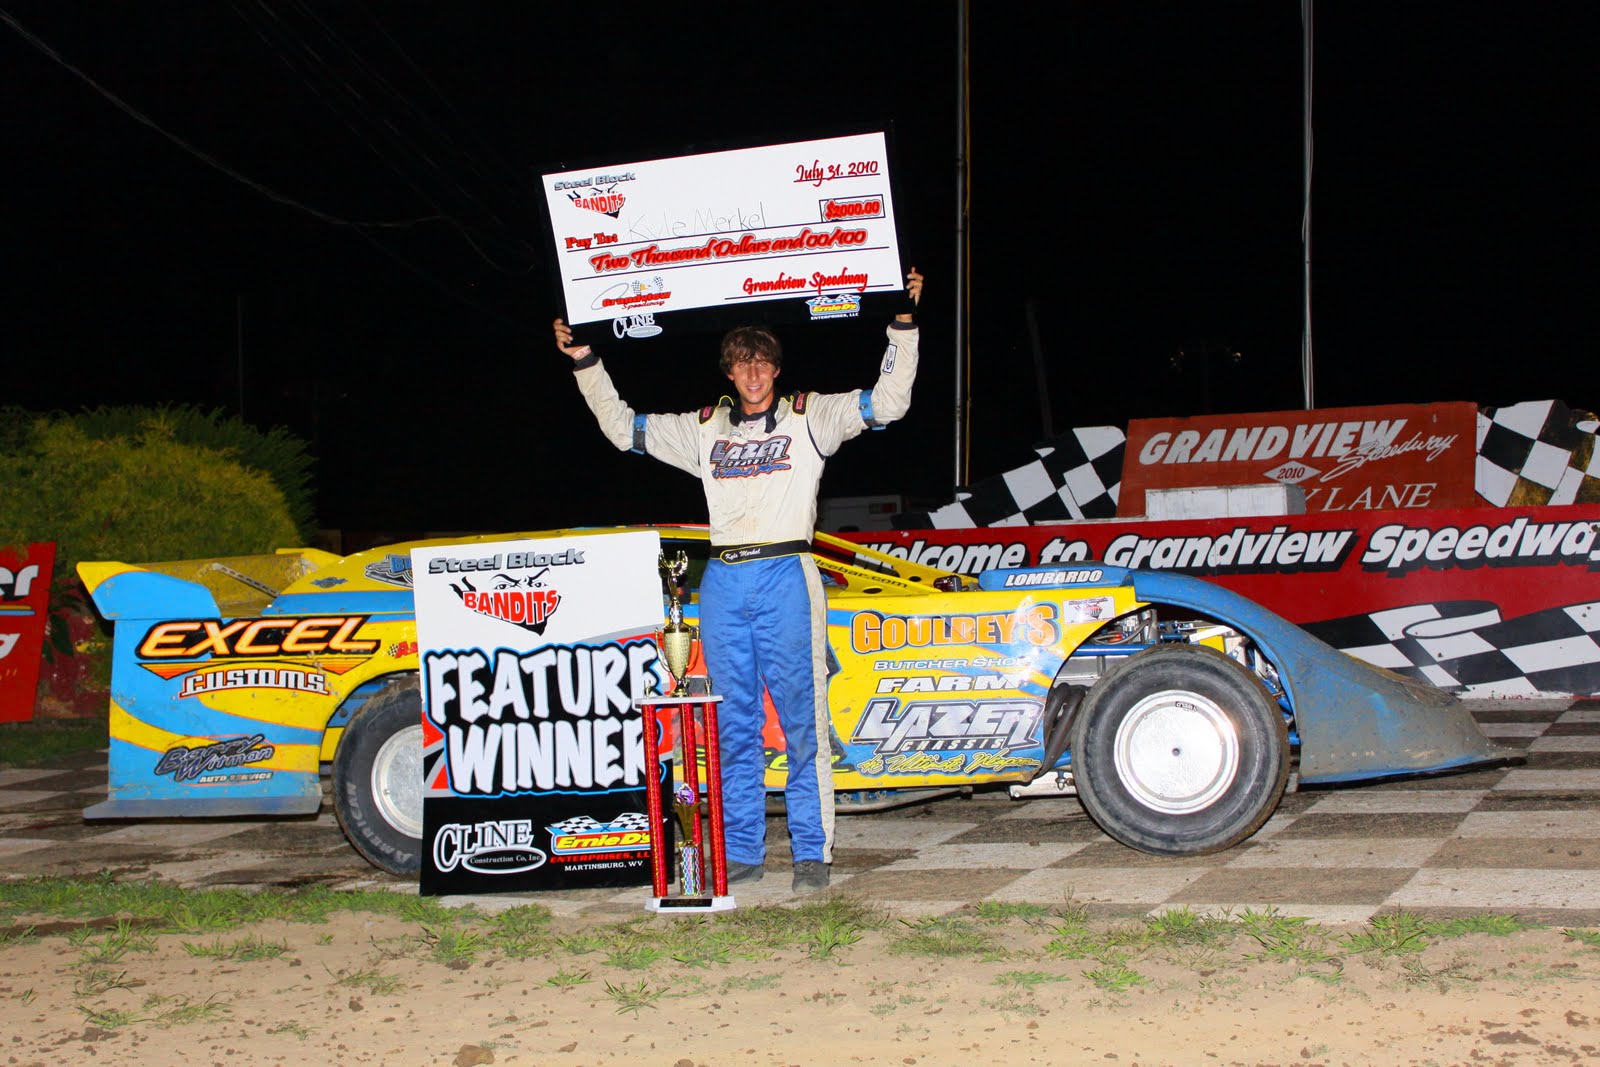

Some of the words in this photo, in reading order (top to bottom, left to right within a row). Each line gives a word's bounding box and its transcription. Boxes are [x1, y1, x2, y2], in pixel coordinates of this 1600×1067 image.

[554, 176, 593, 191] Steel
[595, 172, 636, 185] Block
[795, 159, 823, 187] July
[848, 161, 878, 176] 2010
[574, 193, 625, 214] BANDITS
[824, 199, 881, 220] $2000.00
[628, 210, 686, 245] Kyle
[694, 201, 767, 235] Merkel
[565, 236, 592, 249] Pay
[594, 232, 618, 245] To:
[589, 252, 631, 273] Two
[631, 236, 716, 268] Thousand
[714, 232, 772, 259] Dollars
[771, 228, 809, 253] and
[806, 226, 867, 250] 00/100
[743, 272, 806, 295] Grandview
[809, 267, 868, 294] Speedway
[602, 291, 671, 307] Grandview
[622, 300, 665, 310] Speedway
[613, 313, 655, 339] CLINE
[711, 436, 790, 467] LAZER
[1139, 418, 1408, 465] GRANDVIEW
[1320, 431, 1458, 482] Speedway
[1277, 466, 1306, 480] 2010
[1321, 483, 1437, 512] LANE
[428, 552, 502, 574] Steel
[505, 548, 585, 571] Block
[1039, 538, 1088, 565] to
[1103, 527, 1355, 569] Grandview
[1005, 569, 1103, 588] LOMBARDO
[462, 589, 561, 626] BANDITS
[138, 616, 379, 658] EXCEL
[852, 603, 1059, 653] GOULDEY'S
[873, 659, 970, 671] BUTCHER
[179, 669, 329, 698] CUSTOMS
[427, 641, 658, 723] FEATURE
[876, 674, 1022, 694] FARM
[851, 699, 1046, 755] LAZER
[155, 734, 265, 774] Barry
[448, 718, 648, 793] WINNER
[901, 738, 1003, 751] CHASSIS
[174, 746, 275, 783] Witman
[199, 774, 227, 783] AUTO
[229, 771, 274, 781] SERVICE
[433, 819, 534, 872] CLINE
[556, 835, 620, 849] Ernie
[620, 832, 650, 845] D's
[469, 855, 513, 864] Construction
[550, 852, 633, 863] ENTERPRISES,
[637, 851, 650, 859] LL
